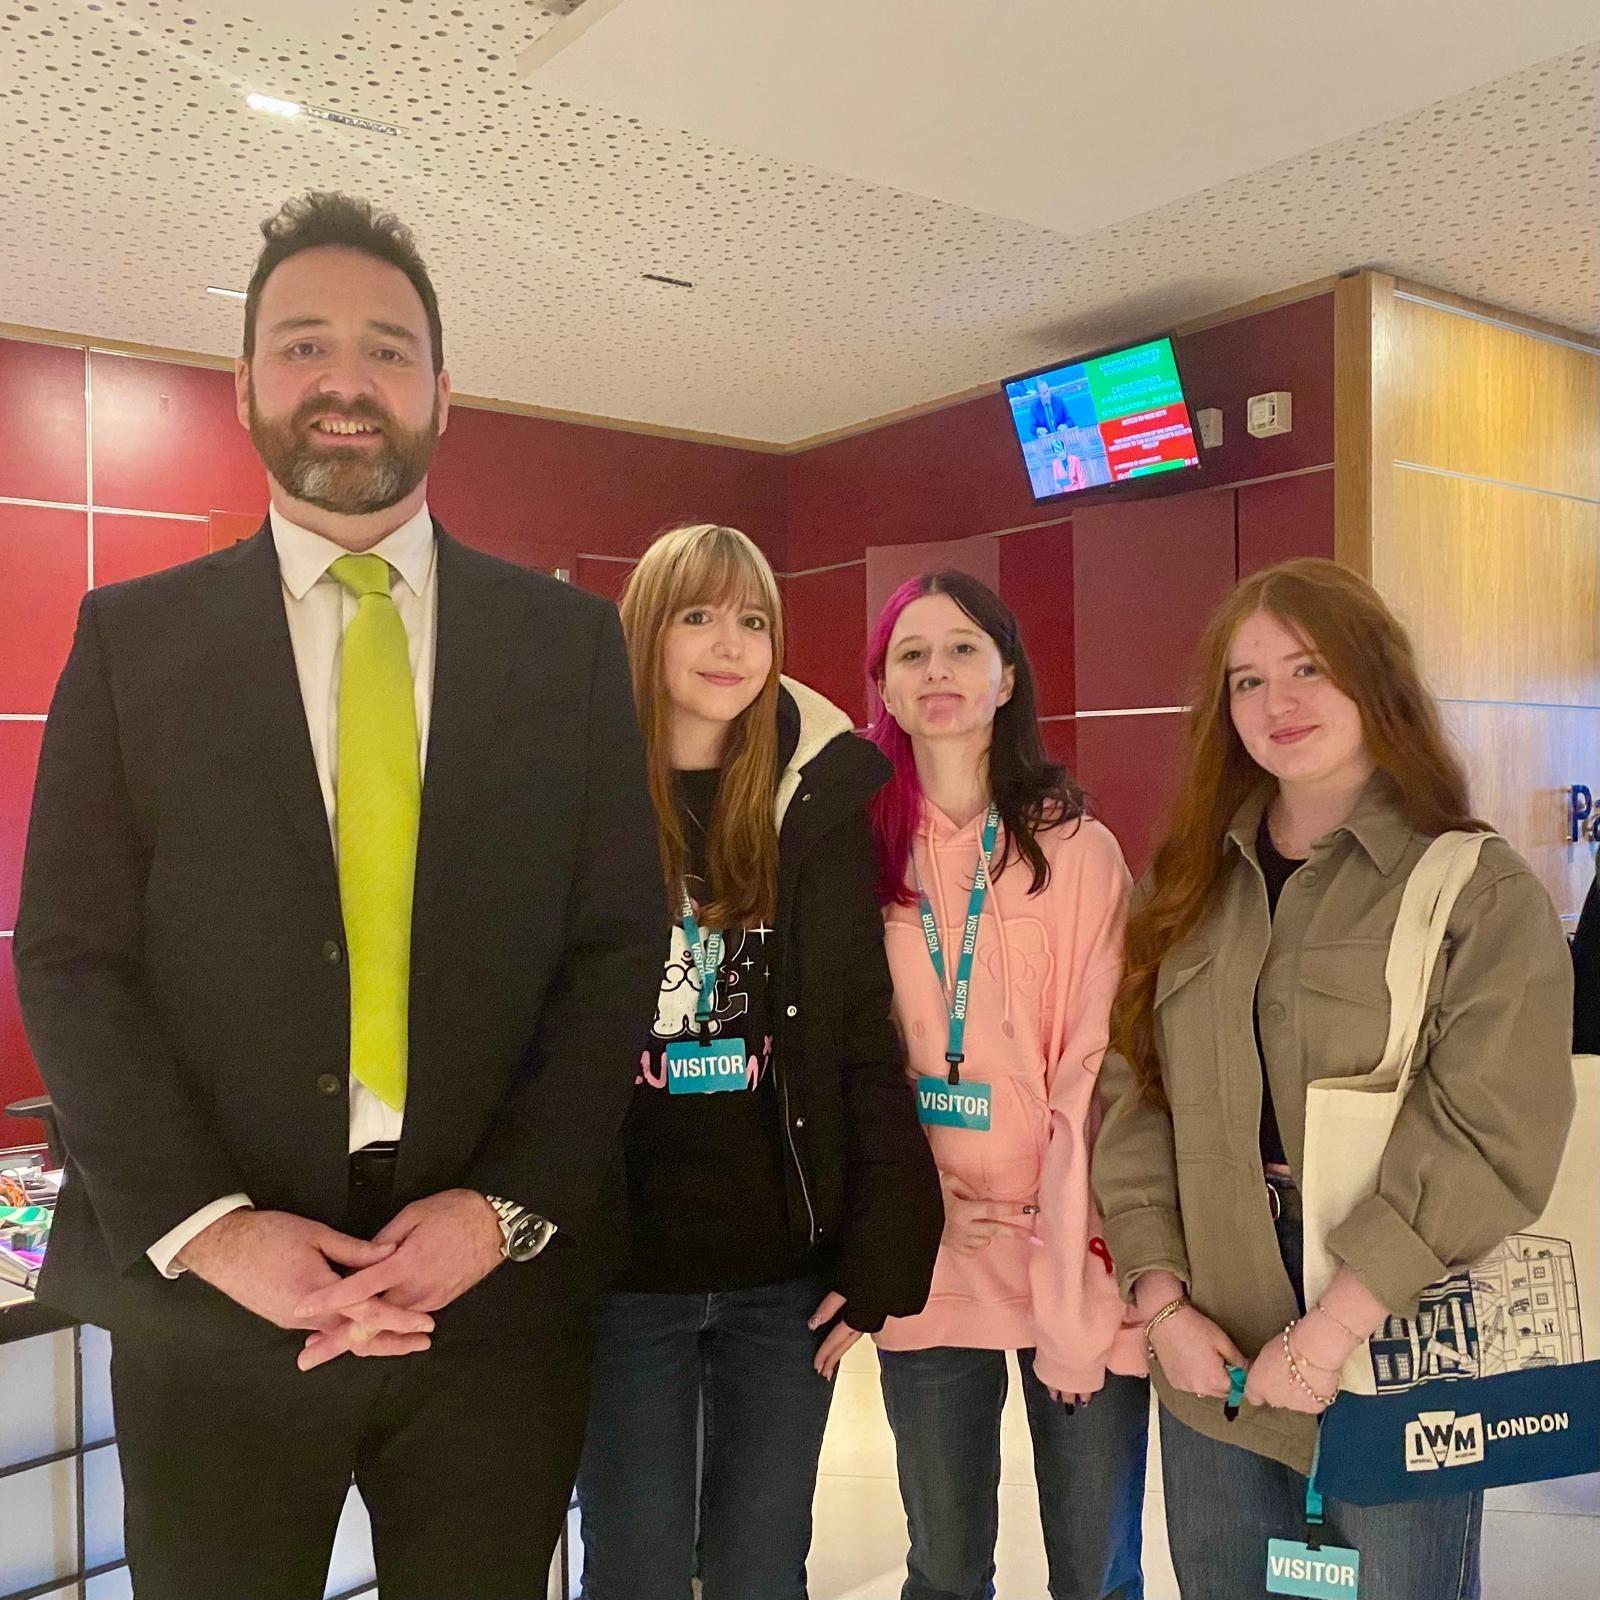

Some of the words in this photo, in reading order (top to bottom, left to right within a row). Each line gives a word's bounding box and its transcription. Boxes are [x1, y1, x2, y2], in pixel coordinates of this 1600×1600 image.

[922, 913, 939, 954] VISITOR
[963, 915, 979, 955] VISITOR
[704, 933, 720, 974] VISITOR
[955, 980, 968, 1020] VISITOR
[669, 1055, 744, 1078] VISITOR
[920, 1091, 989, 1117] VISITOR
[1487, 1412, 1570, 1441] LONDON
[1270, 1556, 1355, 1587] VISITOR
